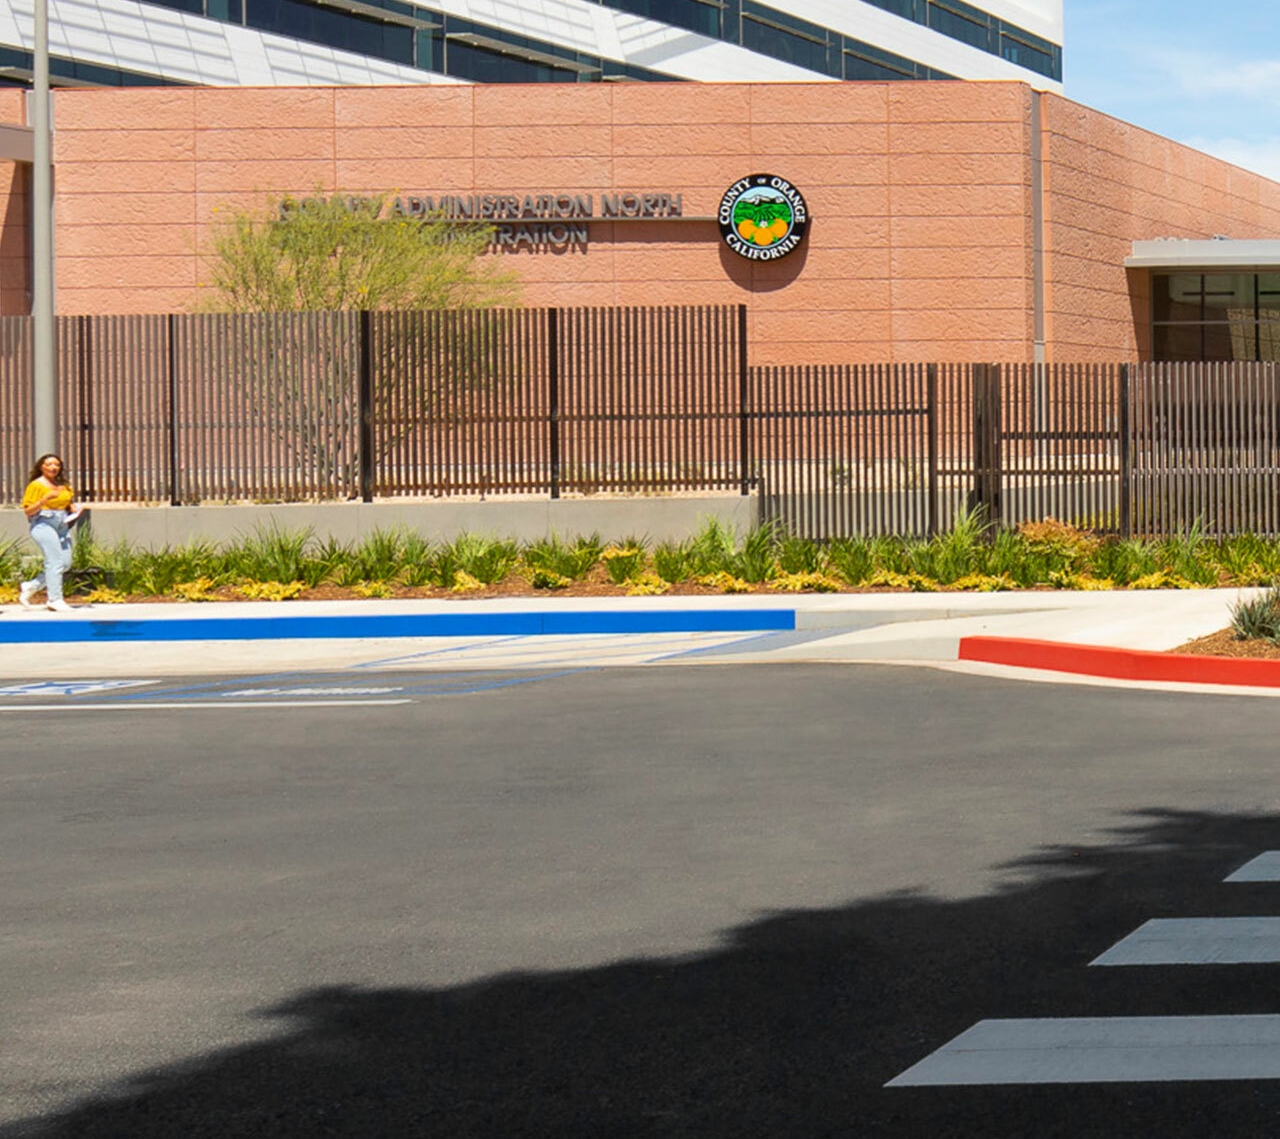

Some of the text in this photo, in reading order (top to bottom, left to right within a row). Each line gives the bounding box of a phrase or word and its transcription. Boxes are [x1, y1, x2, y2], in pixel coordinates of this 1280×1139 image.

[390, 194, 593, 216] ADMINISTRATION
[601, 193, 682, 213] NORTH
[719, 177, 752, 225] COUNTY
[770, 177, 806, 223] ORANGE
[726, 233, 801, 261] CALIFORNIA
